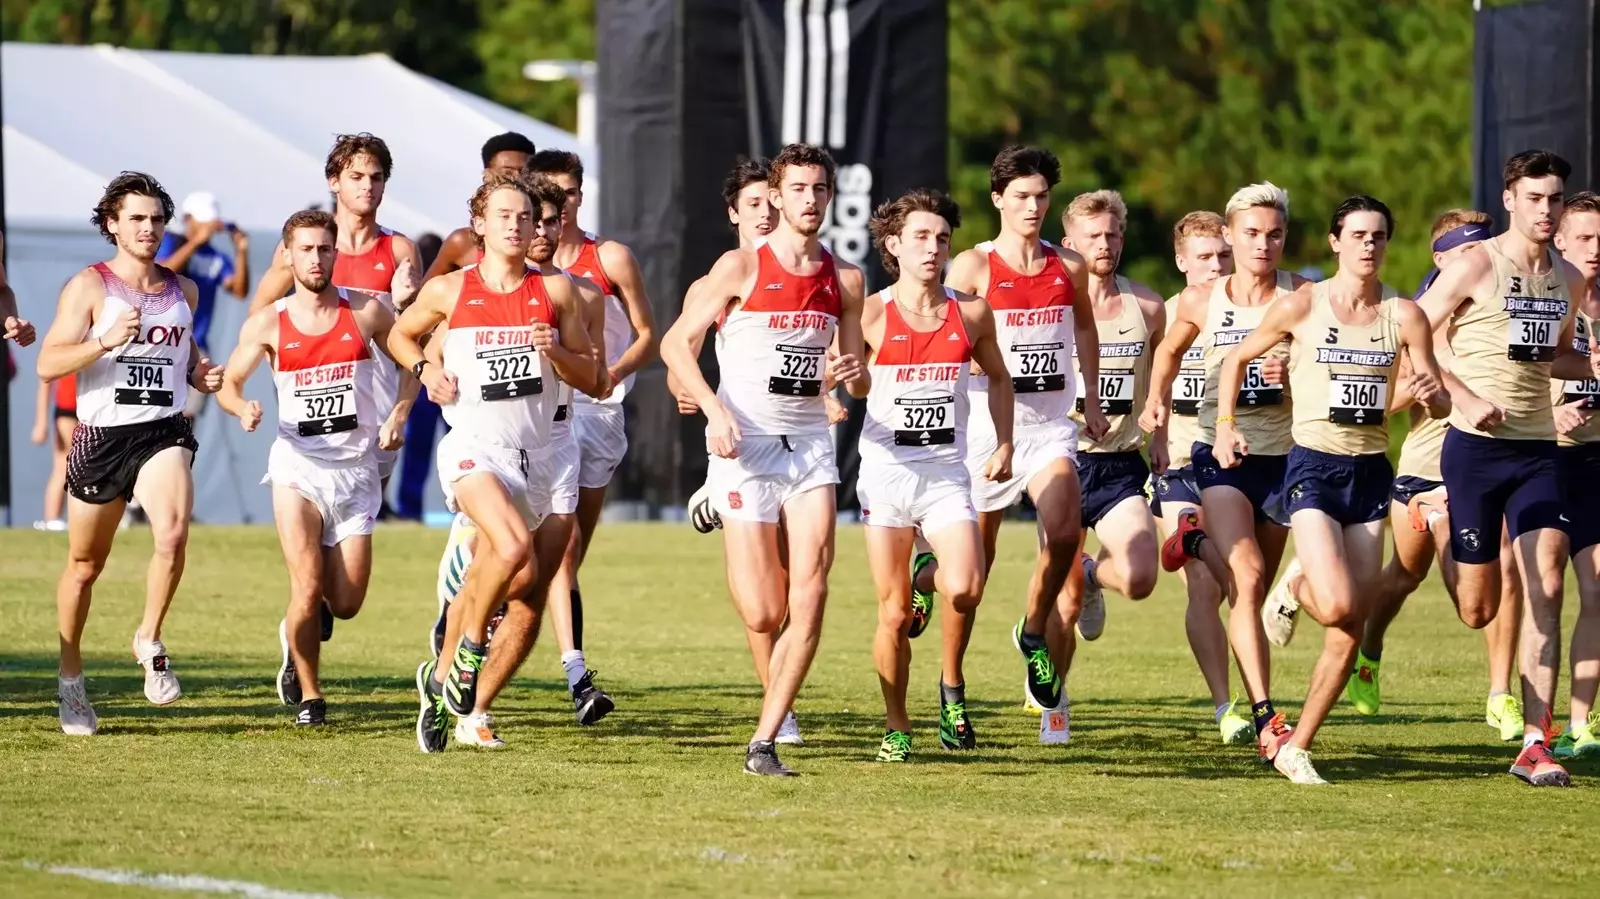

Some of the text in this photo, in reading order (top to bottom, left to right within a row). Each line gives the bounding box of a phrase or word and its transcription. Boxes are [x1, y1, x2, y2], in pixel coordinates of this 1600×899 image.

[768, 314, 829, 330] NC STATE
[1006, 309, 1064, 327] NC STATE
[130, 325, 186, 348] LON
[475, 331, 533, 346] NC STAT
[1521, 321, 1550, 344] 3161
[487, 355, 531, 381] 3222
[780, 354, 819, 378] 3223
[1020, 352, 1058, 375] 3226
[1316, 348, 1396, 367] BUCCANEERS
[127, 365, 163, 388] 3194
[295, 364, 354, 387] NC STATE
[896, 366, 960, 383] NC STATE
[1100, 377, 1123, 397] 167
[1183, 378, 1205, 398] 317
[1341, 383, 1378, 407] 3160
[304, 394, 344, 418] 3227
[903, 406, 946, 428] 3229
